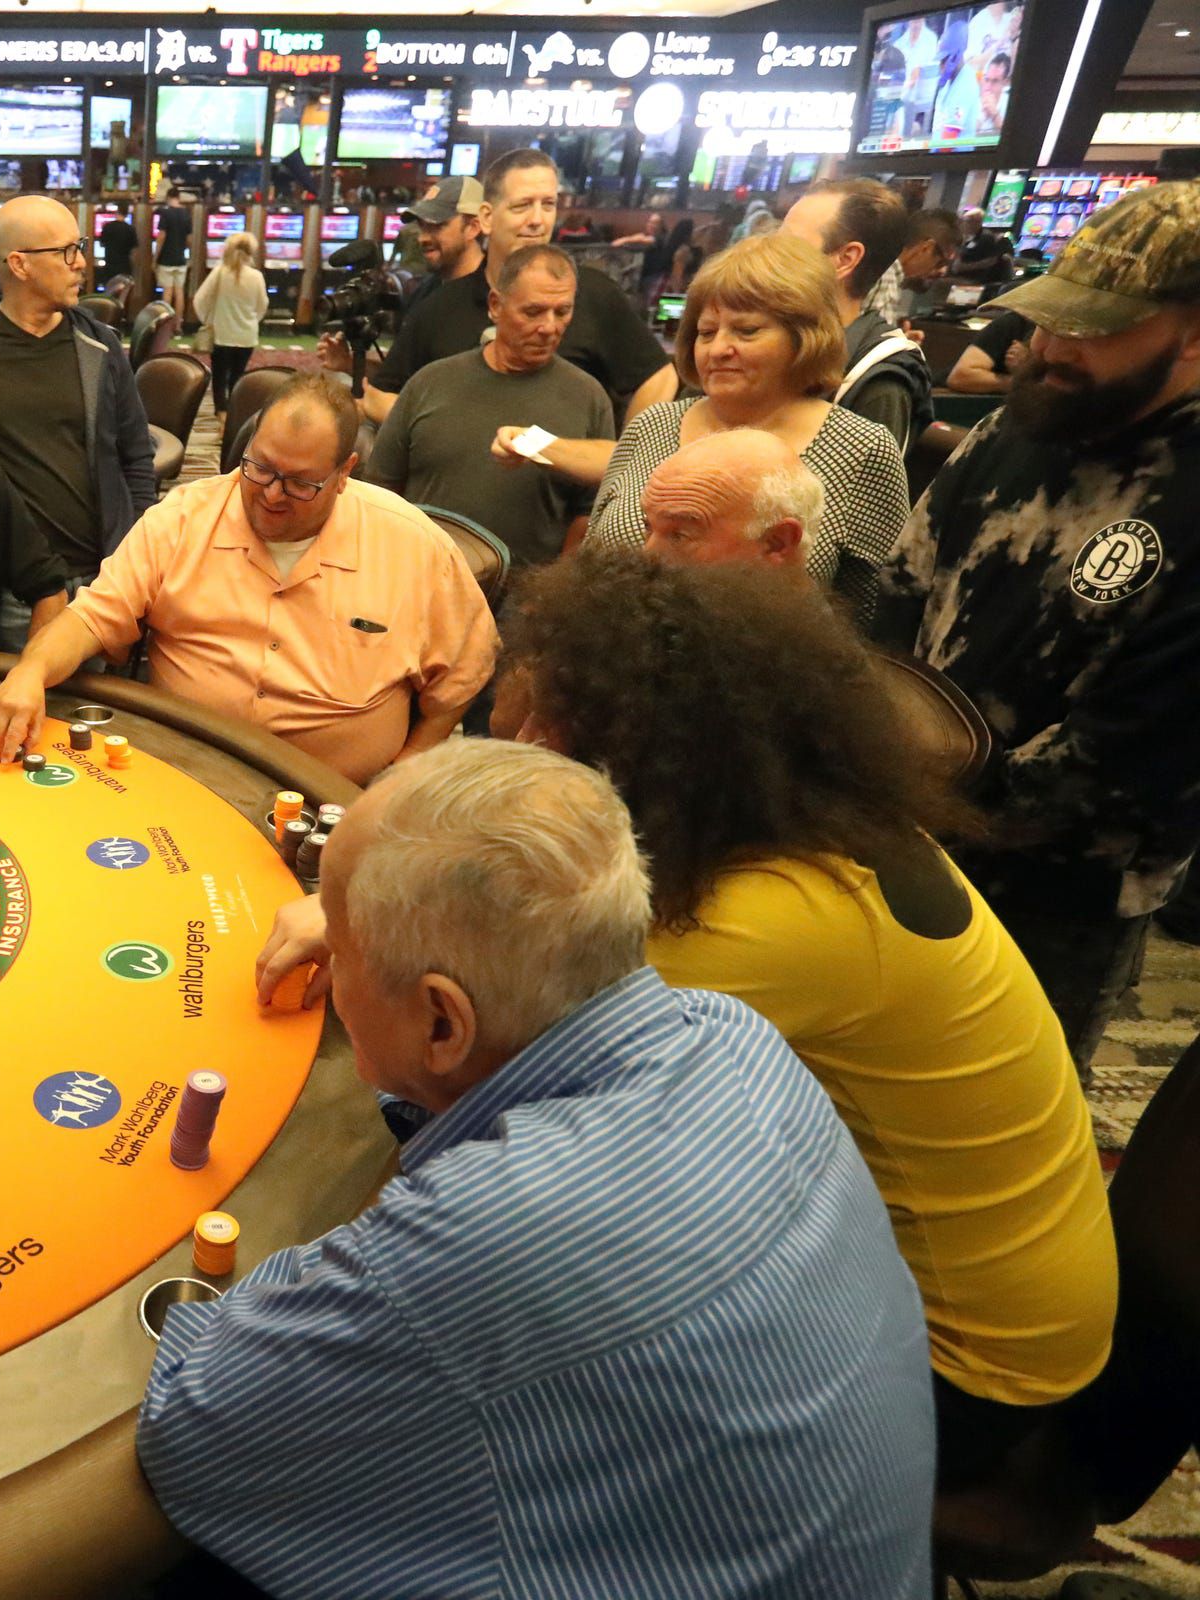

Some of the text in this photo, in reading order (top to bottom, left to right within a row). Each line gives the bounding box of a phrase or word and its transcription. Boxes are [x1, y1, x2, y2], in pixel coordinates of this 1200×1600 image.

[188, 45, 217, 63] vs.
[261, 28, 381, 55] Tigers 9
[376, 43, 509, 65] BOTTOM 6th
[654, 31, 711, 54] Lions
[258, 51, 378, 76] Rangers 2
[576, 48, 604, 66] vs.
[650, 53, 735, 76] Steelers
[819, 45, 858, 67] 1ST
[1095, 522, 1158, 561] BROOKLYN
[1093, 540, 1129, 581] B
[1073, 567, 1133, 600] NEW YORK
[52, 742, 127, 794] wahlburgers
[163, 857, 179, 875] Mark
[176, 854, 191, 873] Youth
[179, 919, 211, 1018] wahlburgers
[99, 1080, 168, 1164] Mark Wahlberg
[117, 1085, 181, 1168] Youth Foundation
